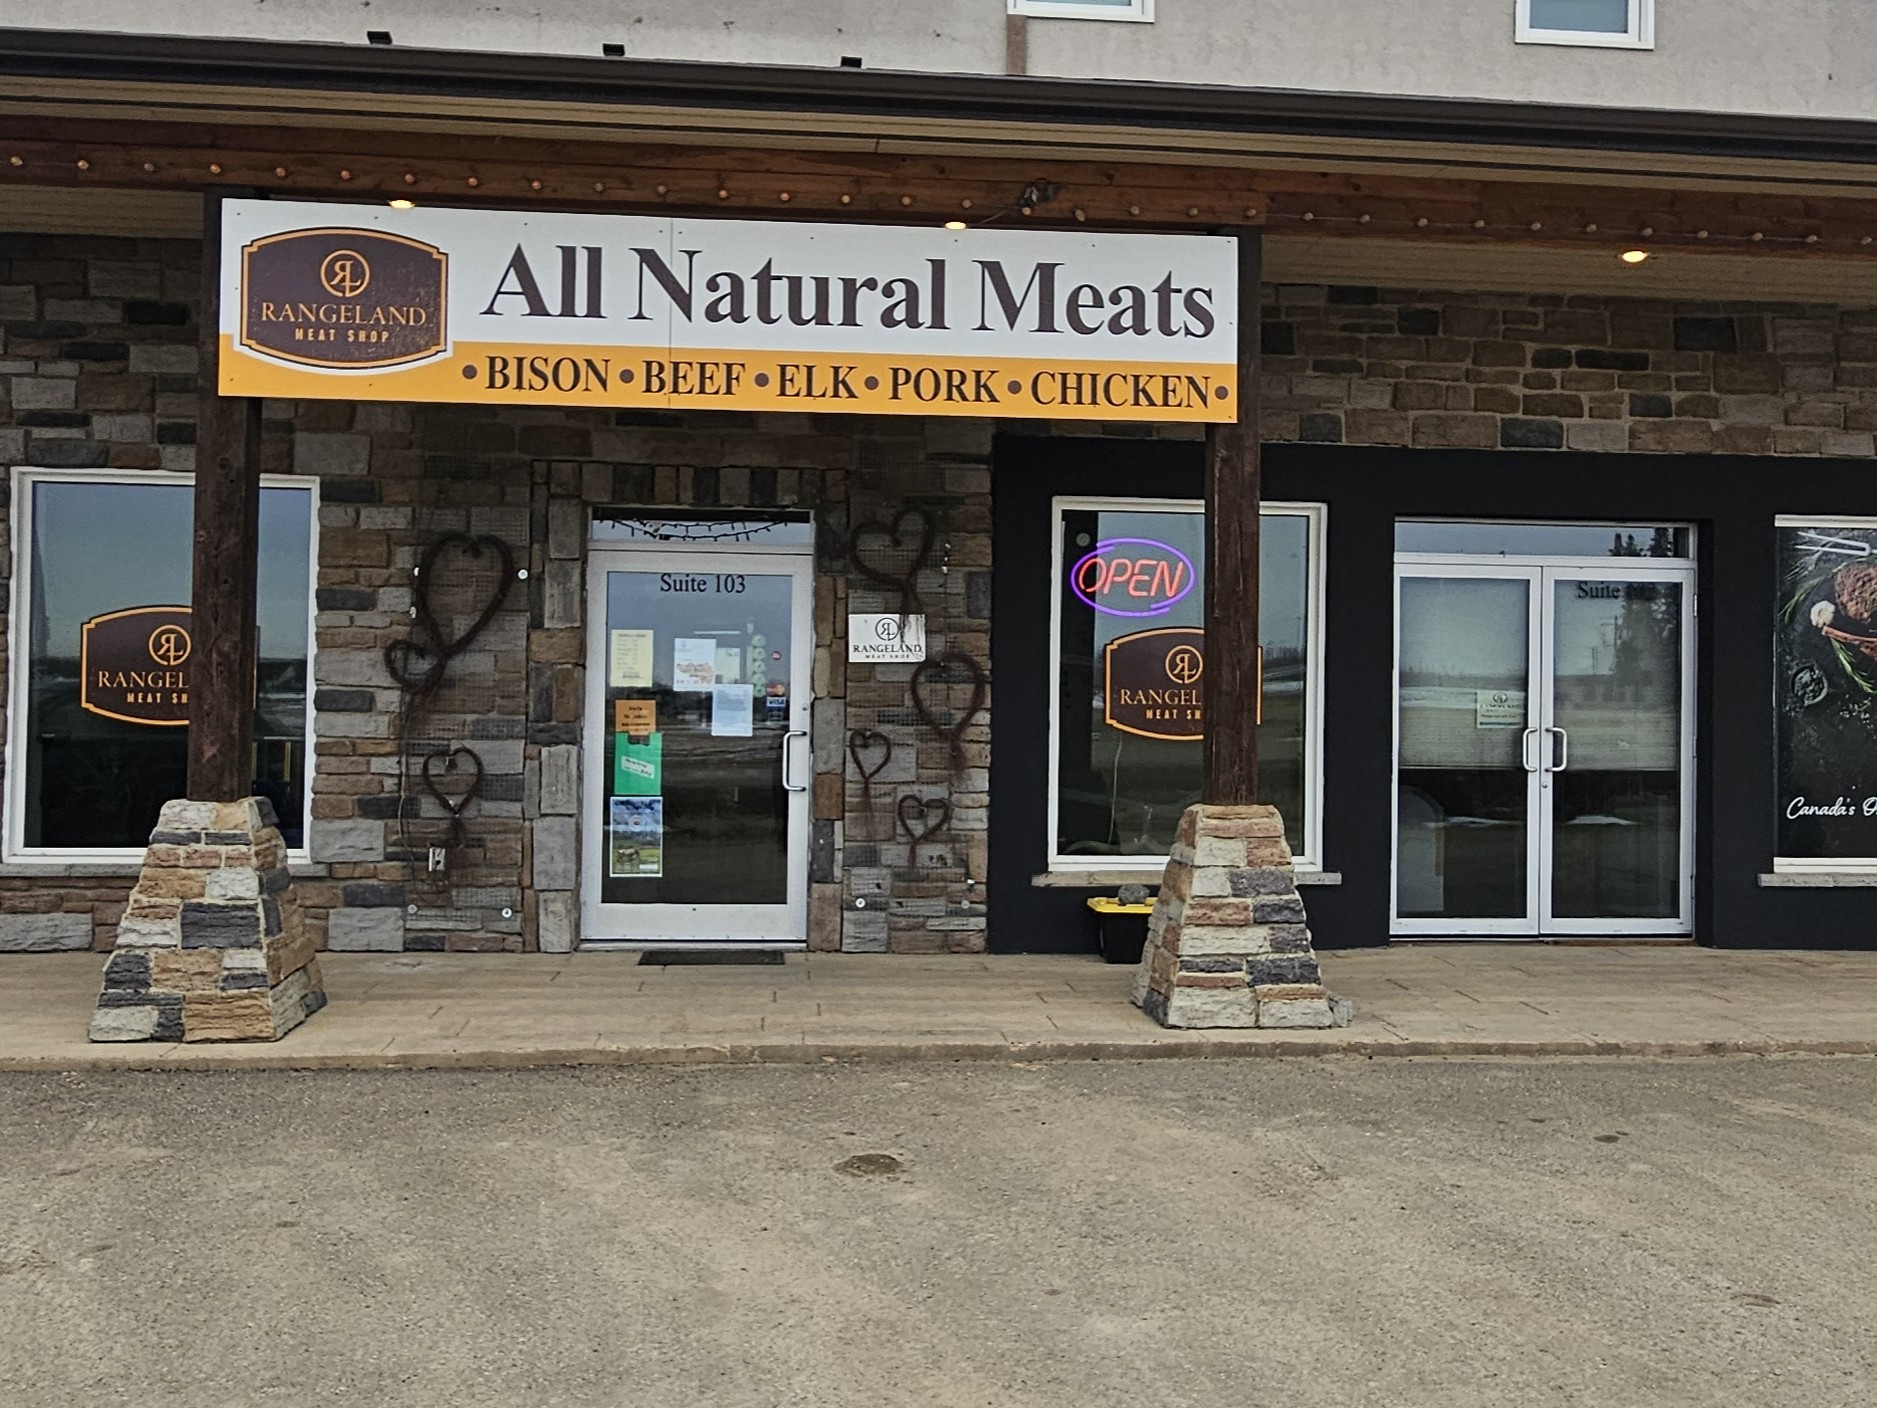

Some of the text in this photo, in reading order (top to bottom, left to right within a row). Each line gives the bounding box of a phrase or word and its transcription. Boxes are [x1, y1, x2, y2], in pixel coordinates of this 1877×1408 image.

[478, 242, 1216, 339] All Natural Meats
[261, 302, 427, 326] RANGELAND
[294, 328, 390, 343] MEAT SHOP
[484, 355, 1211, 409] BISON BEEF ELK PORK CHICKEN
[660, 573, 746, 593] Suite 103
[1078, 557, 1184, 598] OPEN
[1577, 581, 1621, 599] Suite
[853, 644, 924, 653] RANGELAND
[98, 670, 190, 688] RANGEL
[126, 692, 189, 704] MEAT SH
[1120, 688, 1203, 705] RANGEL
[1146, 709, 1202, 719] MEAT SH
[1786, 796, 1856, 819] Canada's
